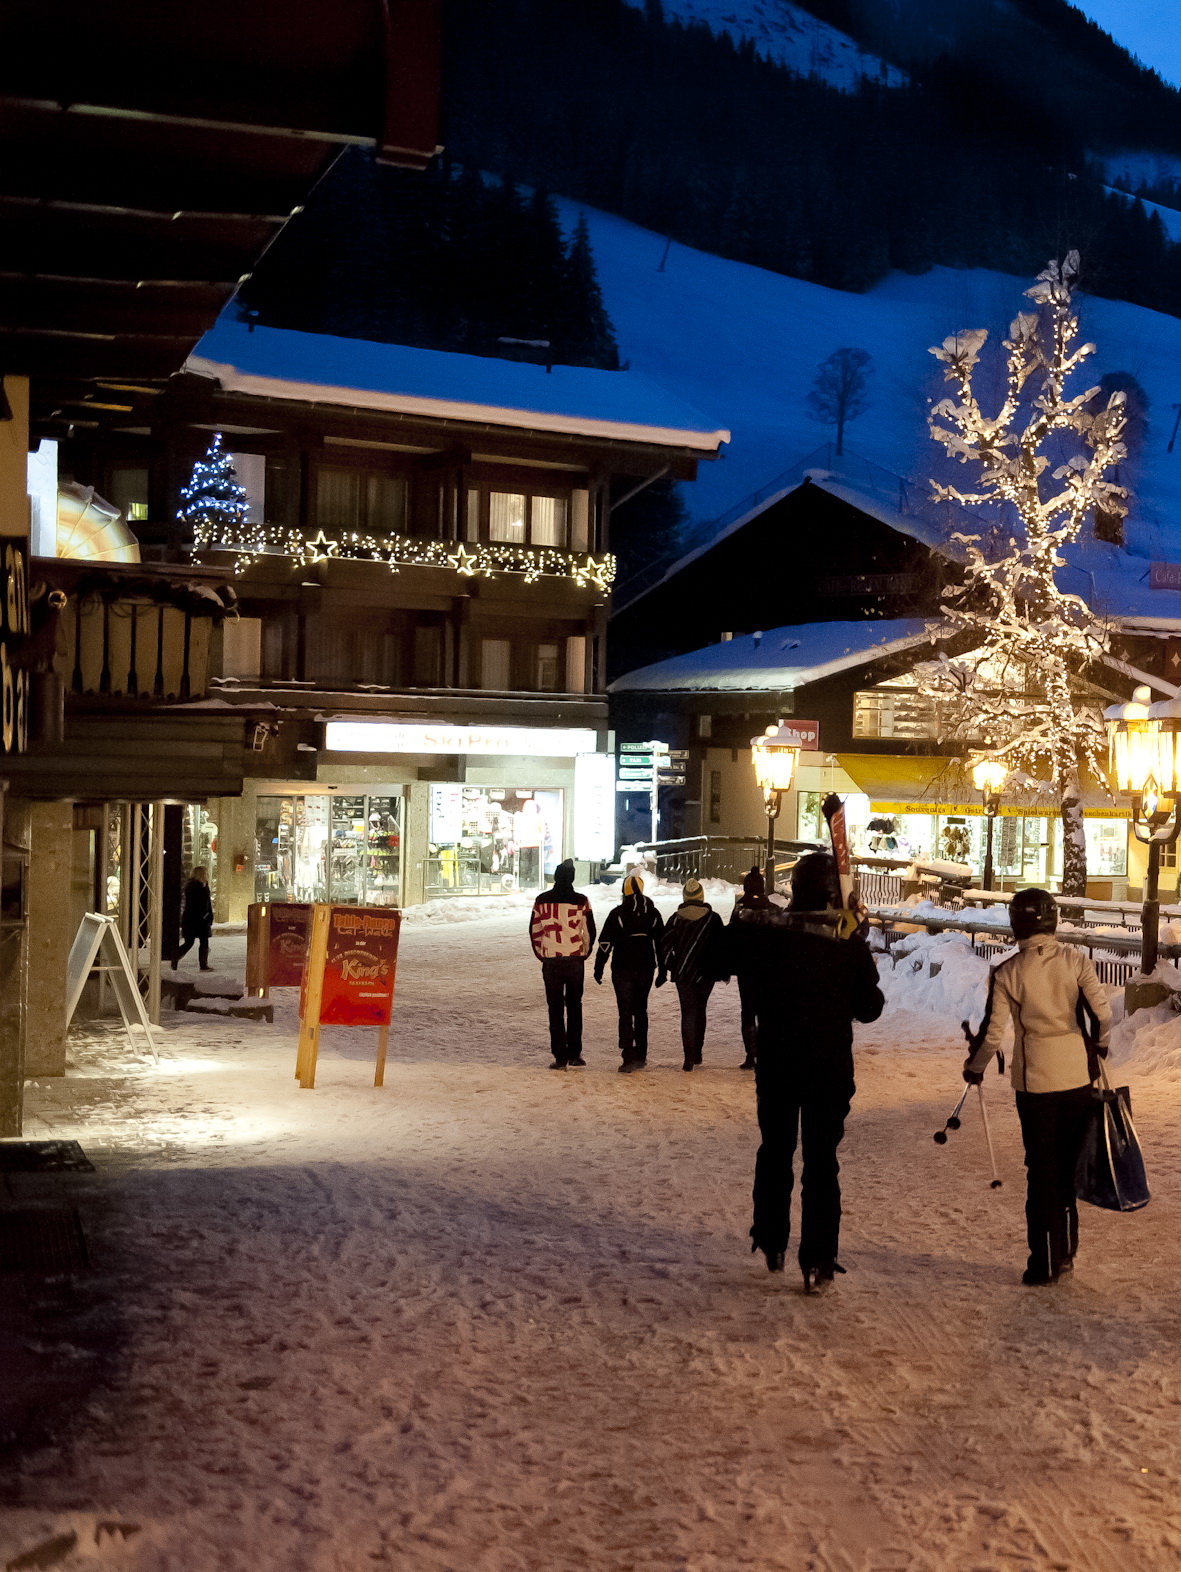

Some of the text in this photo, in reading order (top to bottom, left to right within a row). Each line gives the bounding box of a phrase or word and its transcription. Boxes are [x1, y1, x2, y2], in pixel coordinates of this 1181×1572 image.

[0, 543, 27, 634] an
[790, 728, 816, 742] hop
[340, 957, 390, 981] King's
